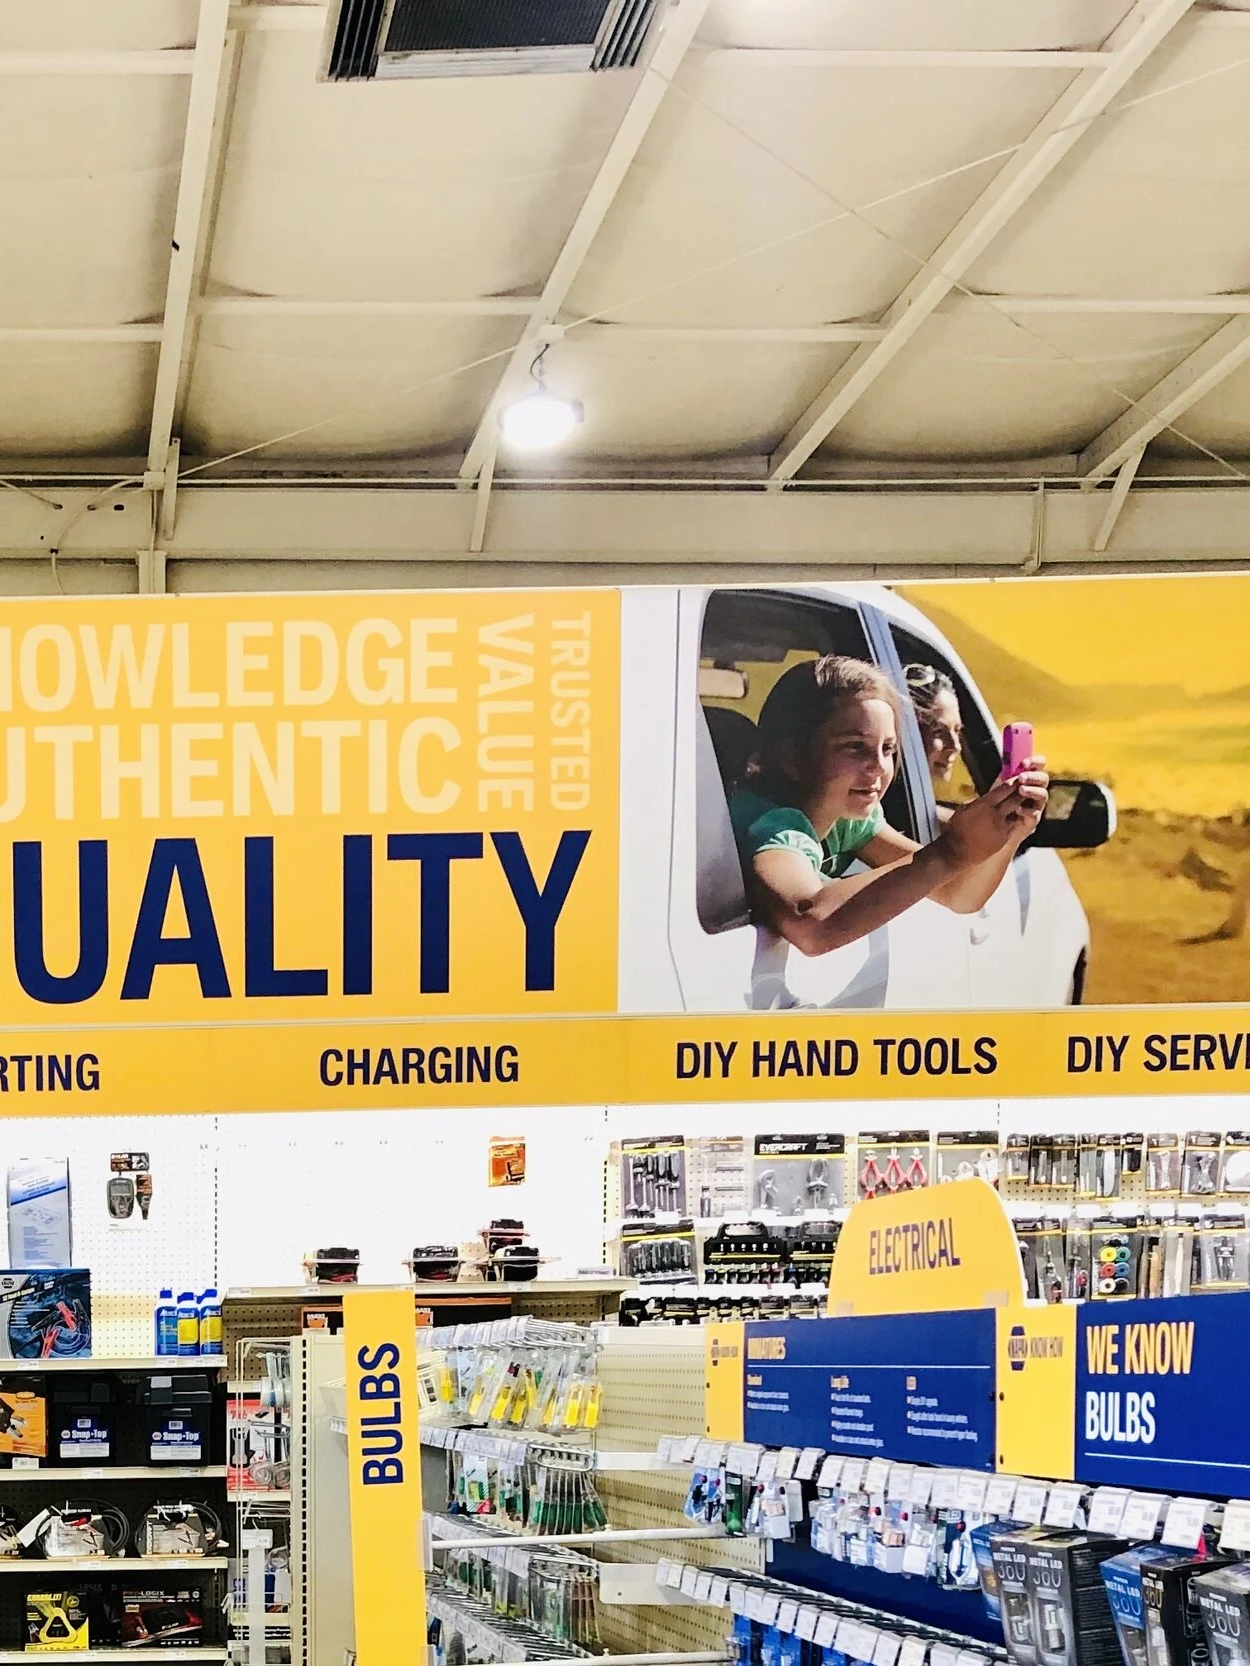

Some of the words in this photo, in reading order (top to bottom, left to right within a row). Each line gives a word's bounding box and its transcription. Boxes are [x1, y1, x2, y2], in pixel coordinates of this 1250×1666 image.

[476, 613, 536, 813] VALUE
[550, 611, 592, 812] TRUSTED
[318, 1045, 519, 1088] CHARGING
[676, 1041, 737, 1079] DIY
[751, 1039, 859, 1078] HAND
[873, 1036, 998, 1075] TOOLS
[1067, 1035, 1129, 1073] DIY
[870, 1217, 960, 1275] ELECTRICAL
[1086, 1325, 1120, 1375] WE
[1125, 1321, 1195, 1375] KNOW
[357, 1343, 404, 1485] BULBS
[1085, 1391, 1156, 1444] BULBS
[1013, 1554, 1026, 1563] LED
[1104, 1580, 1126, 1595] METAL
[1127, 1586, 1141, 1598] LED
